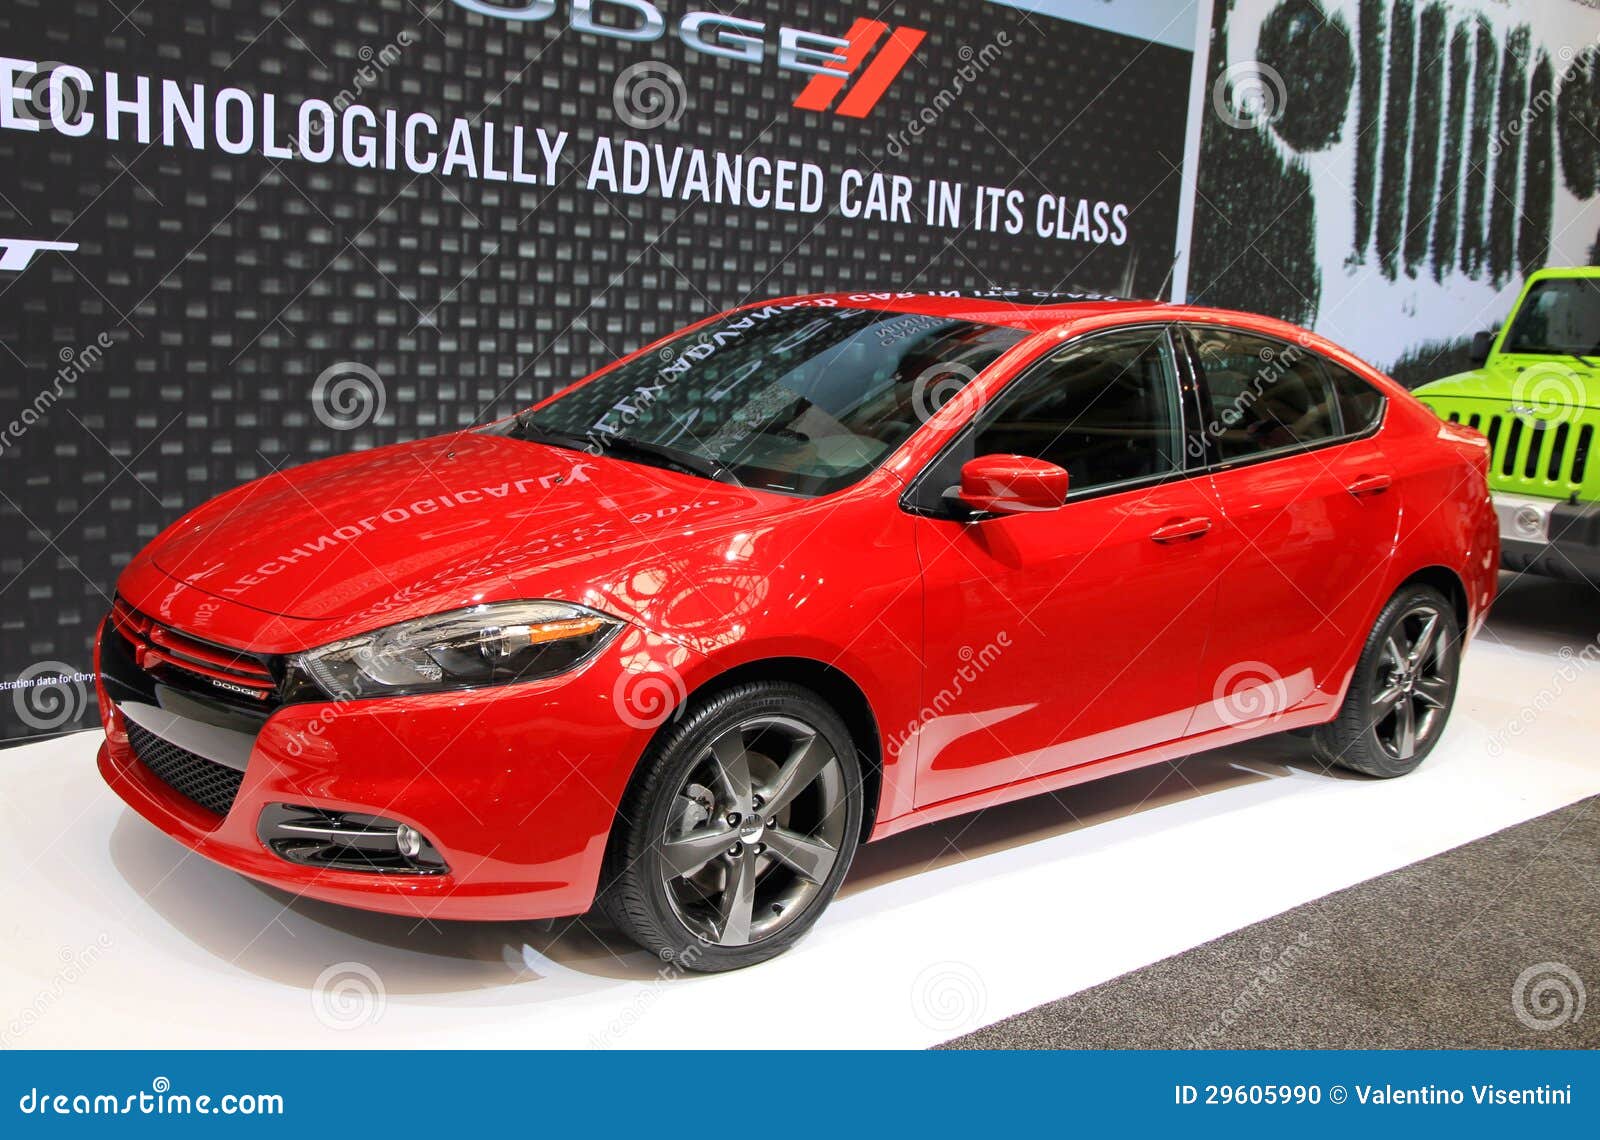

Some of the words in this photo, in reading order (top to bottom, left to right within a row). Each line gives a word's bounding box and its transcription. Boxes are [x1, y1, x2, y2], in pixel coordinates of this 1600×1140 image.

[586, 136, 824, 213] ADVANCED
[840, 169, 912, 223] CAR
[927, 179, 961, 228] IN
[975, 186, 1024, 234] ITS
[1036, 194, 1128, 245] CLASS
[37, 675, 57, 686] data
[59, 673, 73, 684] for
[212, 679, 262, 698] DODGE
